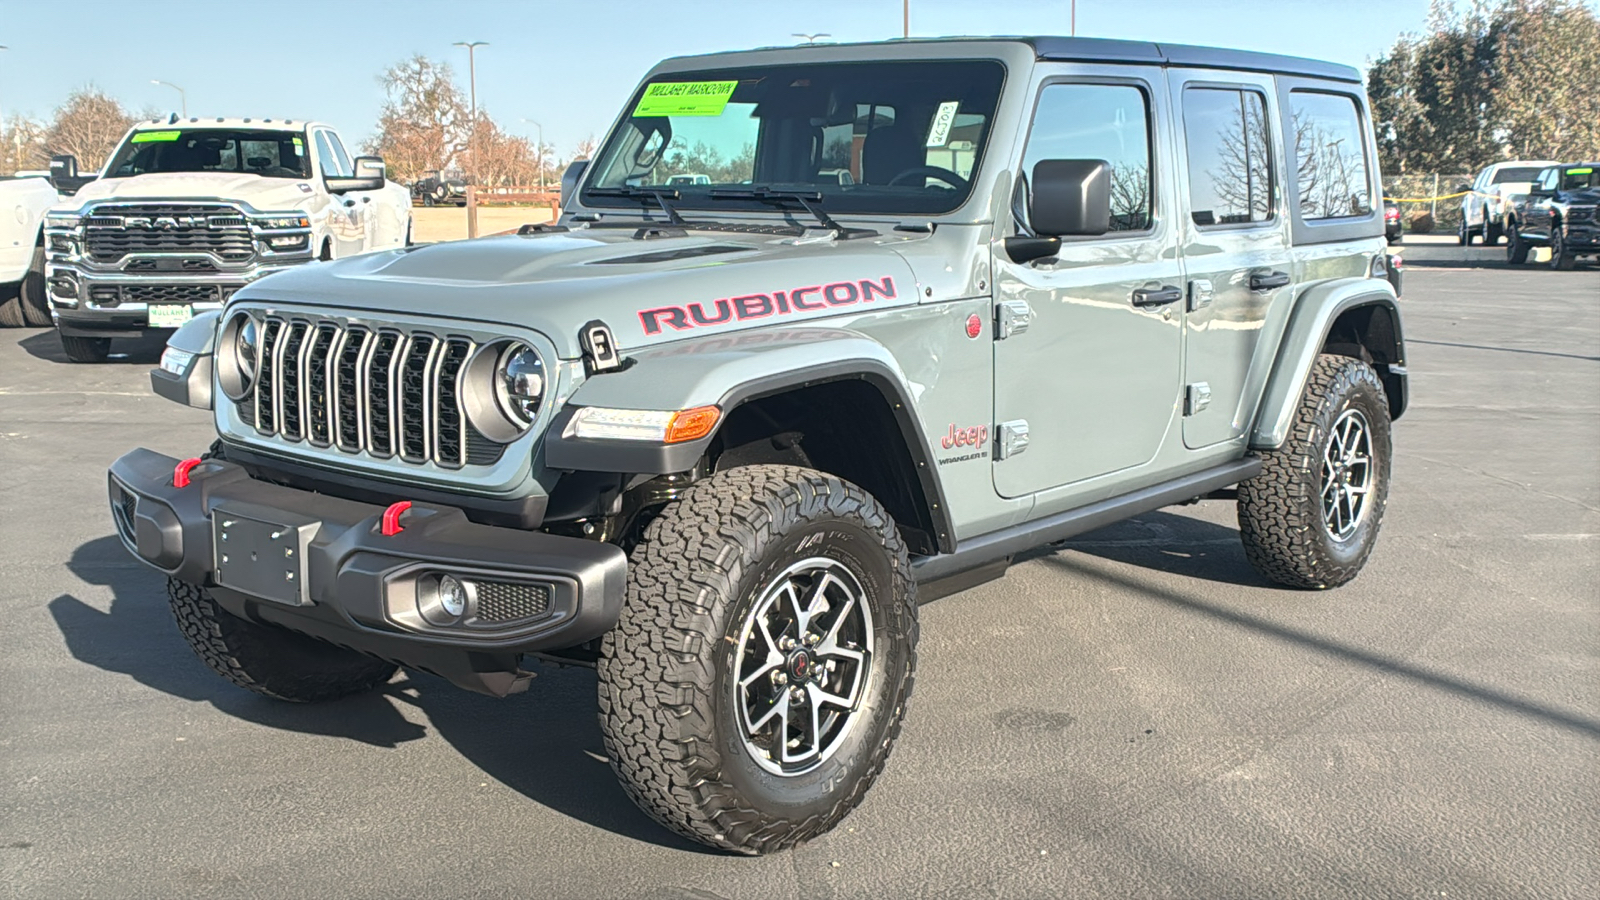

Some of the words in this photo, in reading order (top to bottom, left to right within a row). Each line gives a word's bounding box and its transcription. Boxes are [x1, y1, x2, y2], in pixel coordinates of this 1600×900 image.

[687, 83, 736, 95] MARKDOWN
[125, 217, 206, 229] RAM
[637, 276, 898, 337] RUBICON
[151, 309, 190, 317] MULLAHEY
[941, 422, 989, 450] Jeep
[939, 452, 981, 465] WRANGLER
